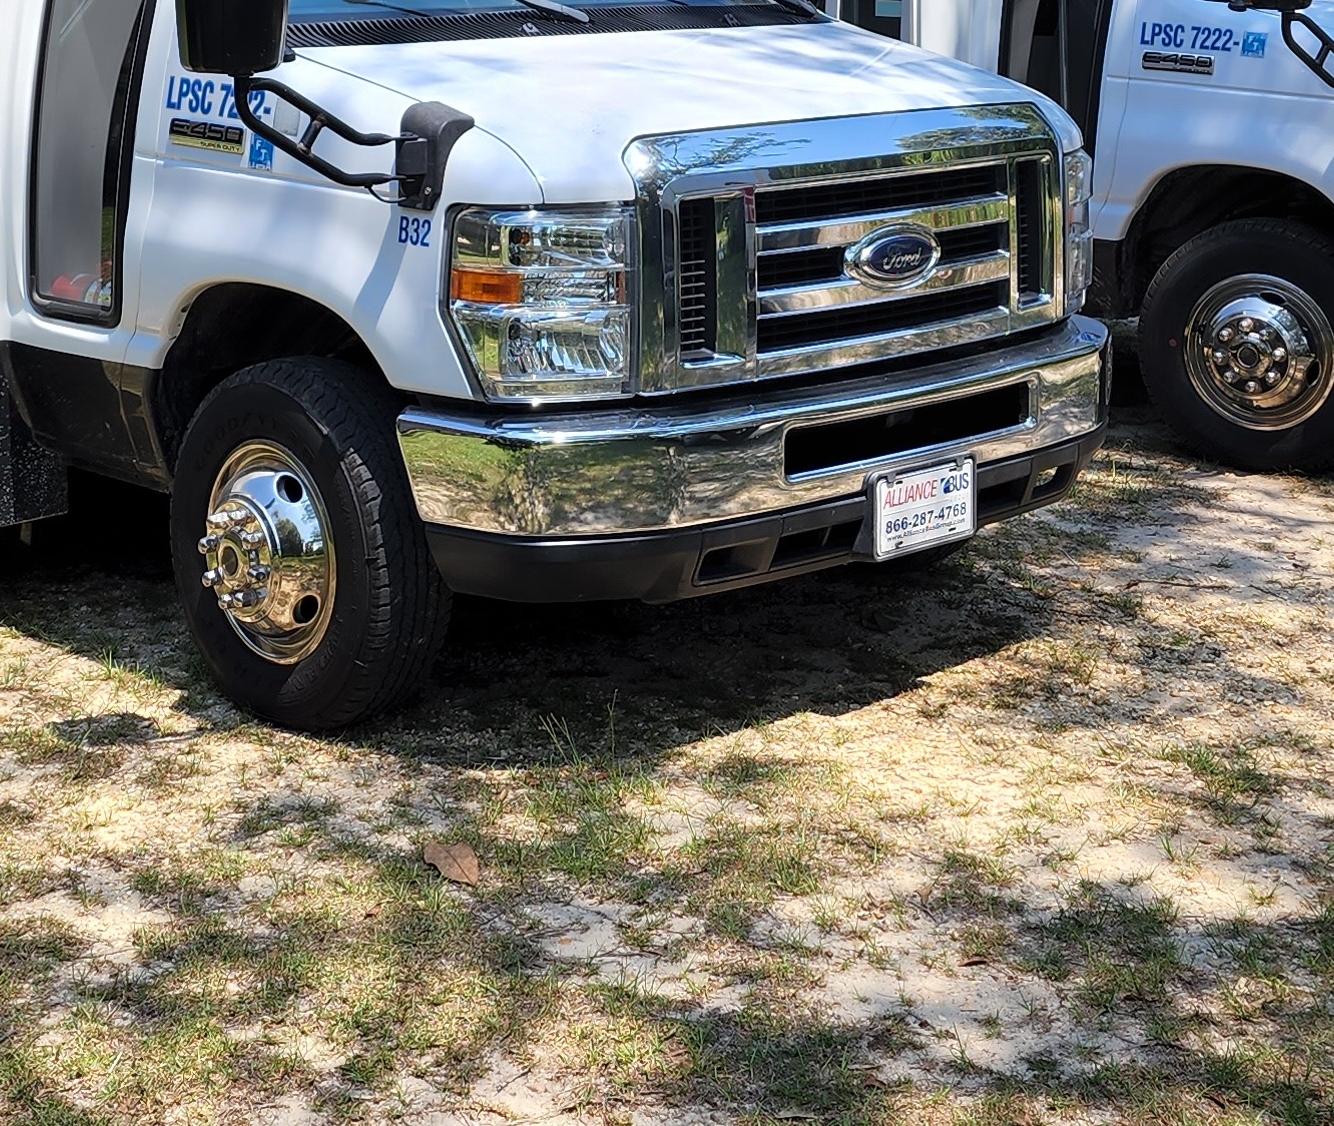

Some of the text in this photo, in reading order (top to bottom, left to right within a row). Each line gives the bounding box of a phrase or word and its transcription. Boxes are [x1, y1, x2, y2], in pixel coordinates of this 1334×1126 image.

[1140, 22, 1240, 52] LPSC 7222-
[166, 75, 215, 115] LPSC
[222, 143, 241, 153] DUTY
[398, 215, 432, 247] B32
[882, 243, 923, 270] Ford
[883, 472, 969, 510] ALLIANCE BUS
[886, 501, 967, 534] 866-287-4768
